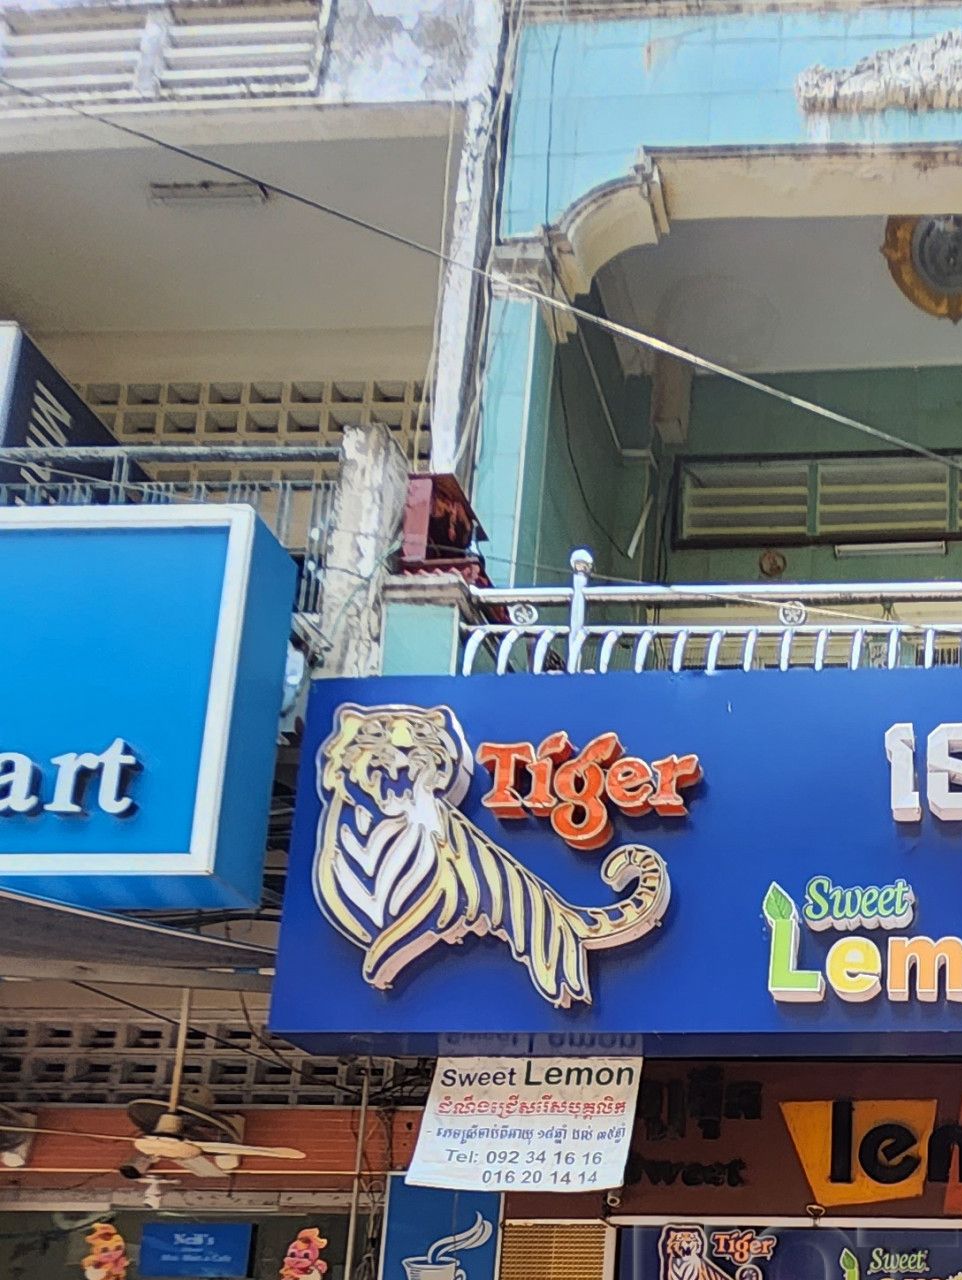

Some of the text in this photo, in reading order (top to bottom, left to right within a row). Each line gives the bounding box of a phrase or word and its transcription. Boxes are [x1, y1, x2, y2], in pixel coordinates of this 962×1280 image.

[475, 730, 702, 850] Tiger
[803, 875, 915, 930] Sweet
[440, 1060, 634, 1087] Sweet Lemon
[445, 1149, 603, 1165] Tel: 092 34 16 16
[482, 1169, 598, 1185] 016 20 14 14
[711, 1227, 778, 1266] Tiger
[866, 1248, 931, 1274] Sweet
